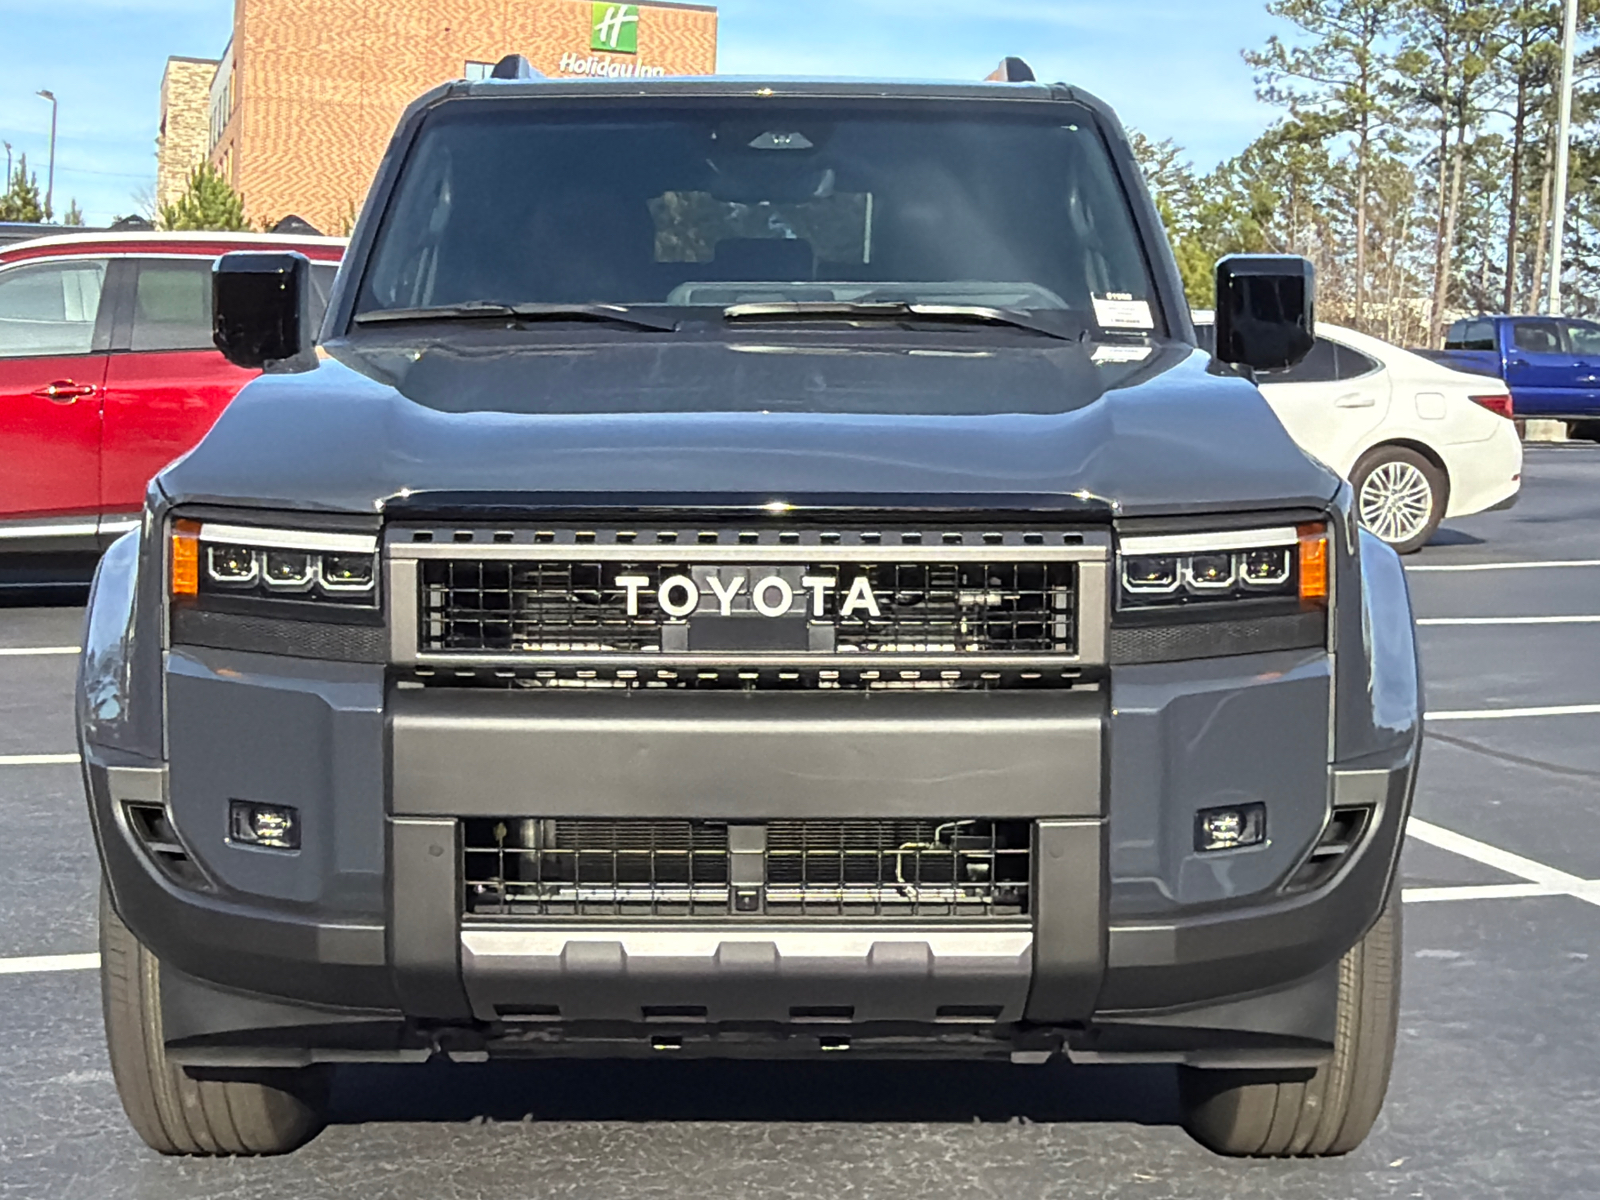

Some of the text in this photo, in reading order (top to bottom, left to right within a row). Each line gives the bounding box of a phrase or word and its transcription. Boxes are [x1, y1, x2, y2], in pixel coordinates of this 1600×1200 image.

[594, 5, 639, 48] H
[634, 58, 665, 78] Inn
[615, 575, 881, 617] TOYOTA
